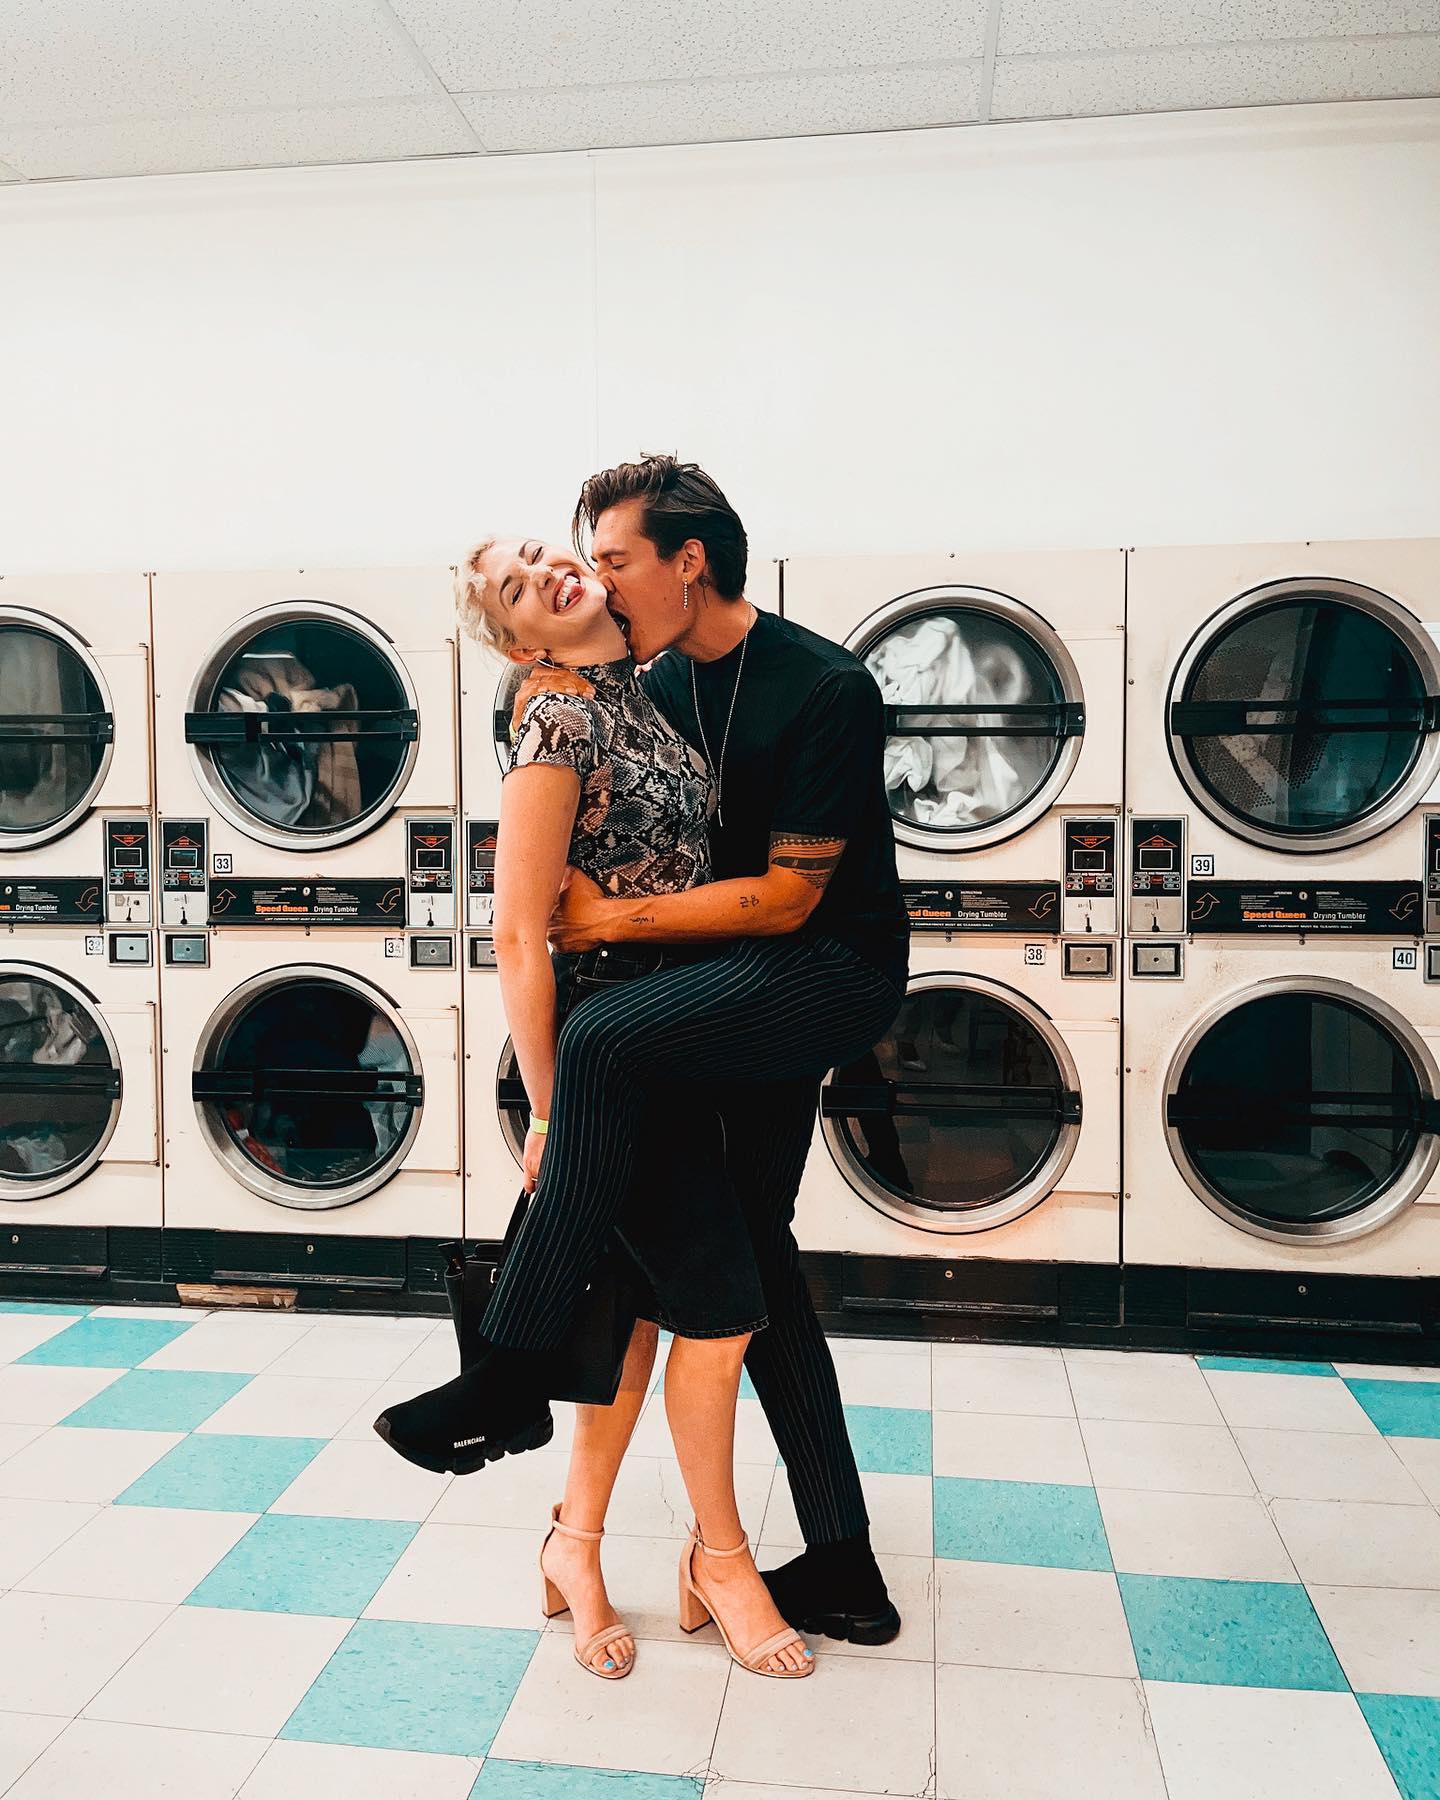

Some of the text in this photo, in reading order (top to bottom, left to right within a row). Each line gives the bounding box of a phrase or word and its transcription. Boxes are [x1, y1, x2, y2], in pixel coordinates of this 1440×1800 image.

[216, 858, 229, 869] 33
[1195, 859, 1210, 872] 39
[15, 904, 34, 912] Drying
[255, 905, 358, 913] Speed Queen Drying Tumbler
[922, 909, 951, 917] Queen
[957, 910, 980, 919] Drying
[980, 910, 1007, 918] Tumbler
[1243, 911, 1366, 920] Speed Queen Drying Tumbler
[1028, 948, 1043, 961] 38
[1397, 952, 1413, 965] 40
[453, 1435, 486, 1449] BALENCIAGA
